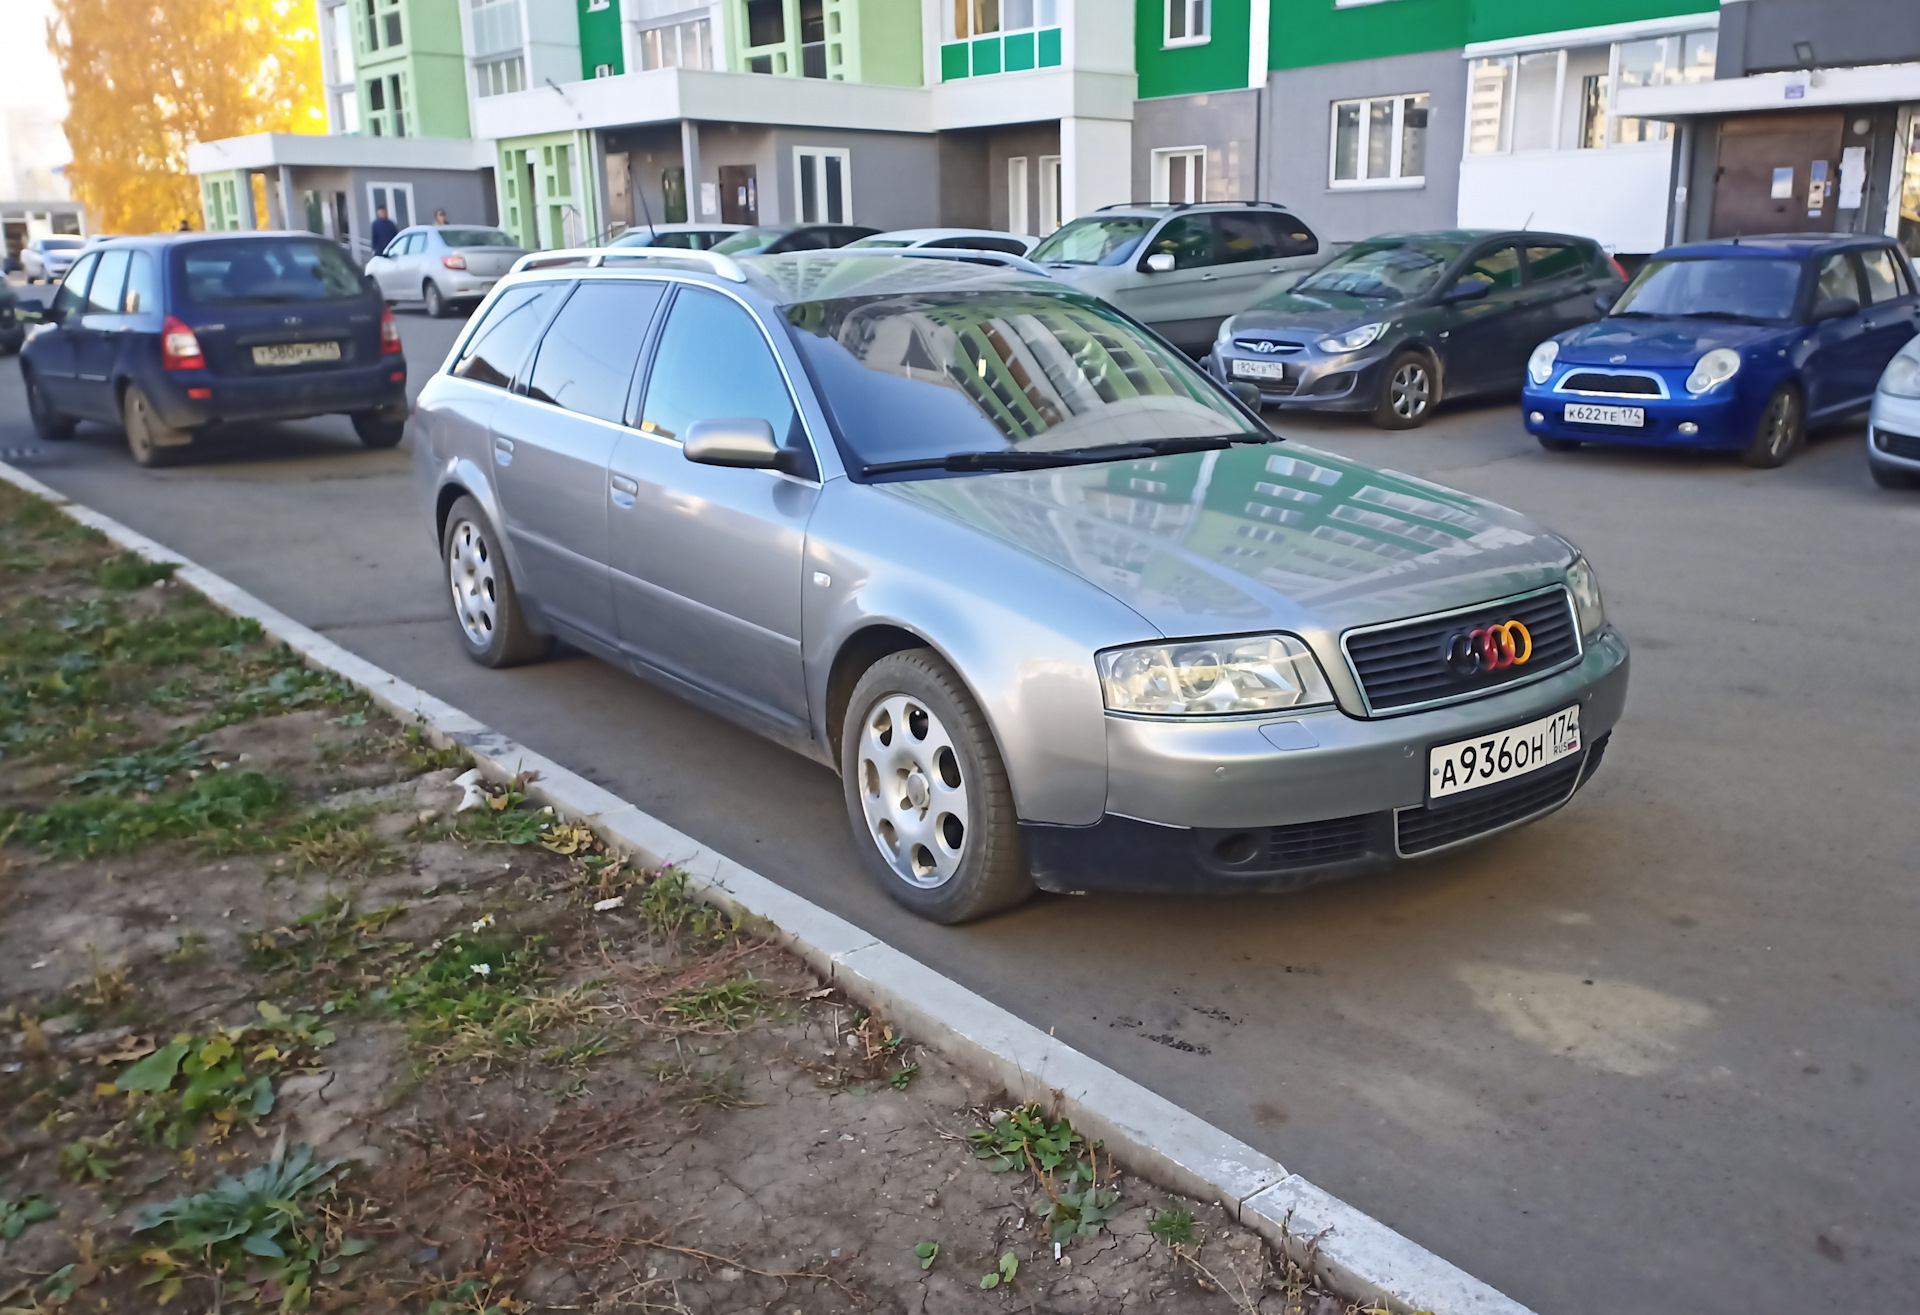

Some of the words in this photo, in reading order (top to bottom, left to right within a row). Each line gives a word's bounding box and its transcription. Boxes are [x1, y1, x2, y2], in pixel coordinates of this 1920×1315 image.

[1569, 406, 1617, 422] К622ТЕ
[1621, 408, 1641, 420] 174
[1440, 733, 1544, 790] А936ОН
[1548, 710, 1578, 746] 174
[1553, 742, 1568, 756] RUS
